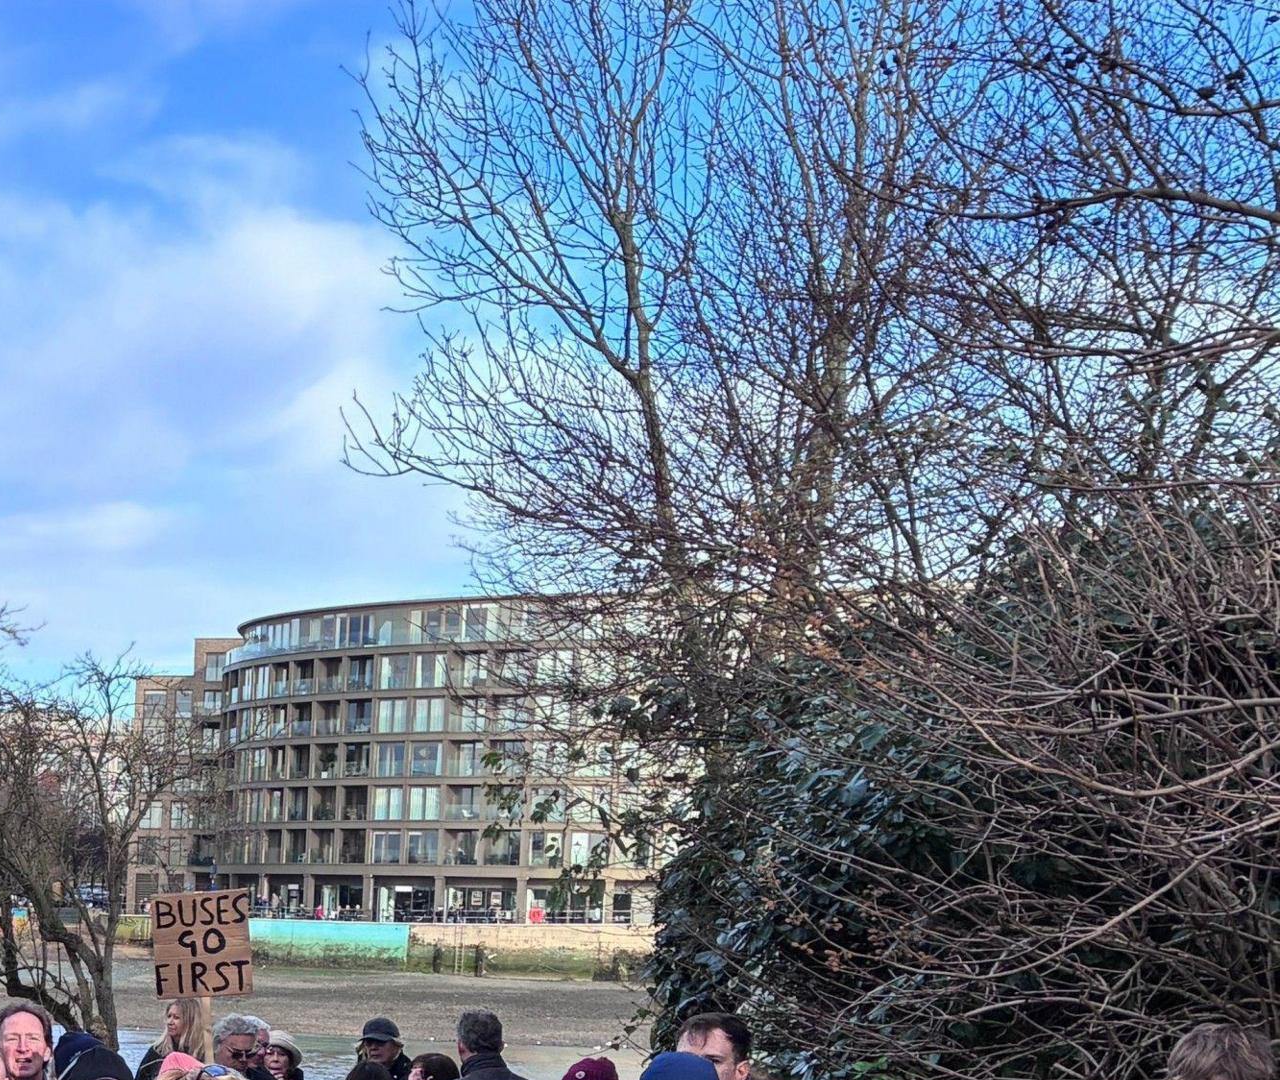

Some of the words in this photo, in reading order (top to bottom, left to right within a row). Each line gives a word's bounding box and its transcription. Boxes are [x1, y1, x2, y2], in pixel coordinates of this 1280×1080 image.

[155, 893, 247, 929] BUSES
[178, 928, 226, 957] GO
[155, 960, 250, 996] FIRST
